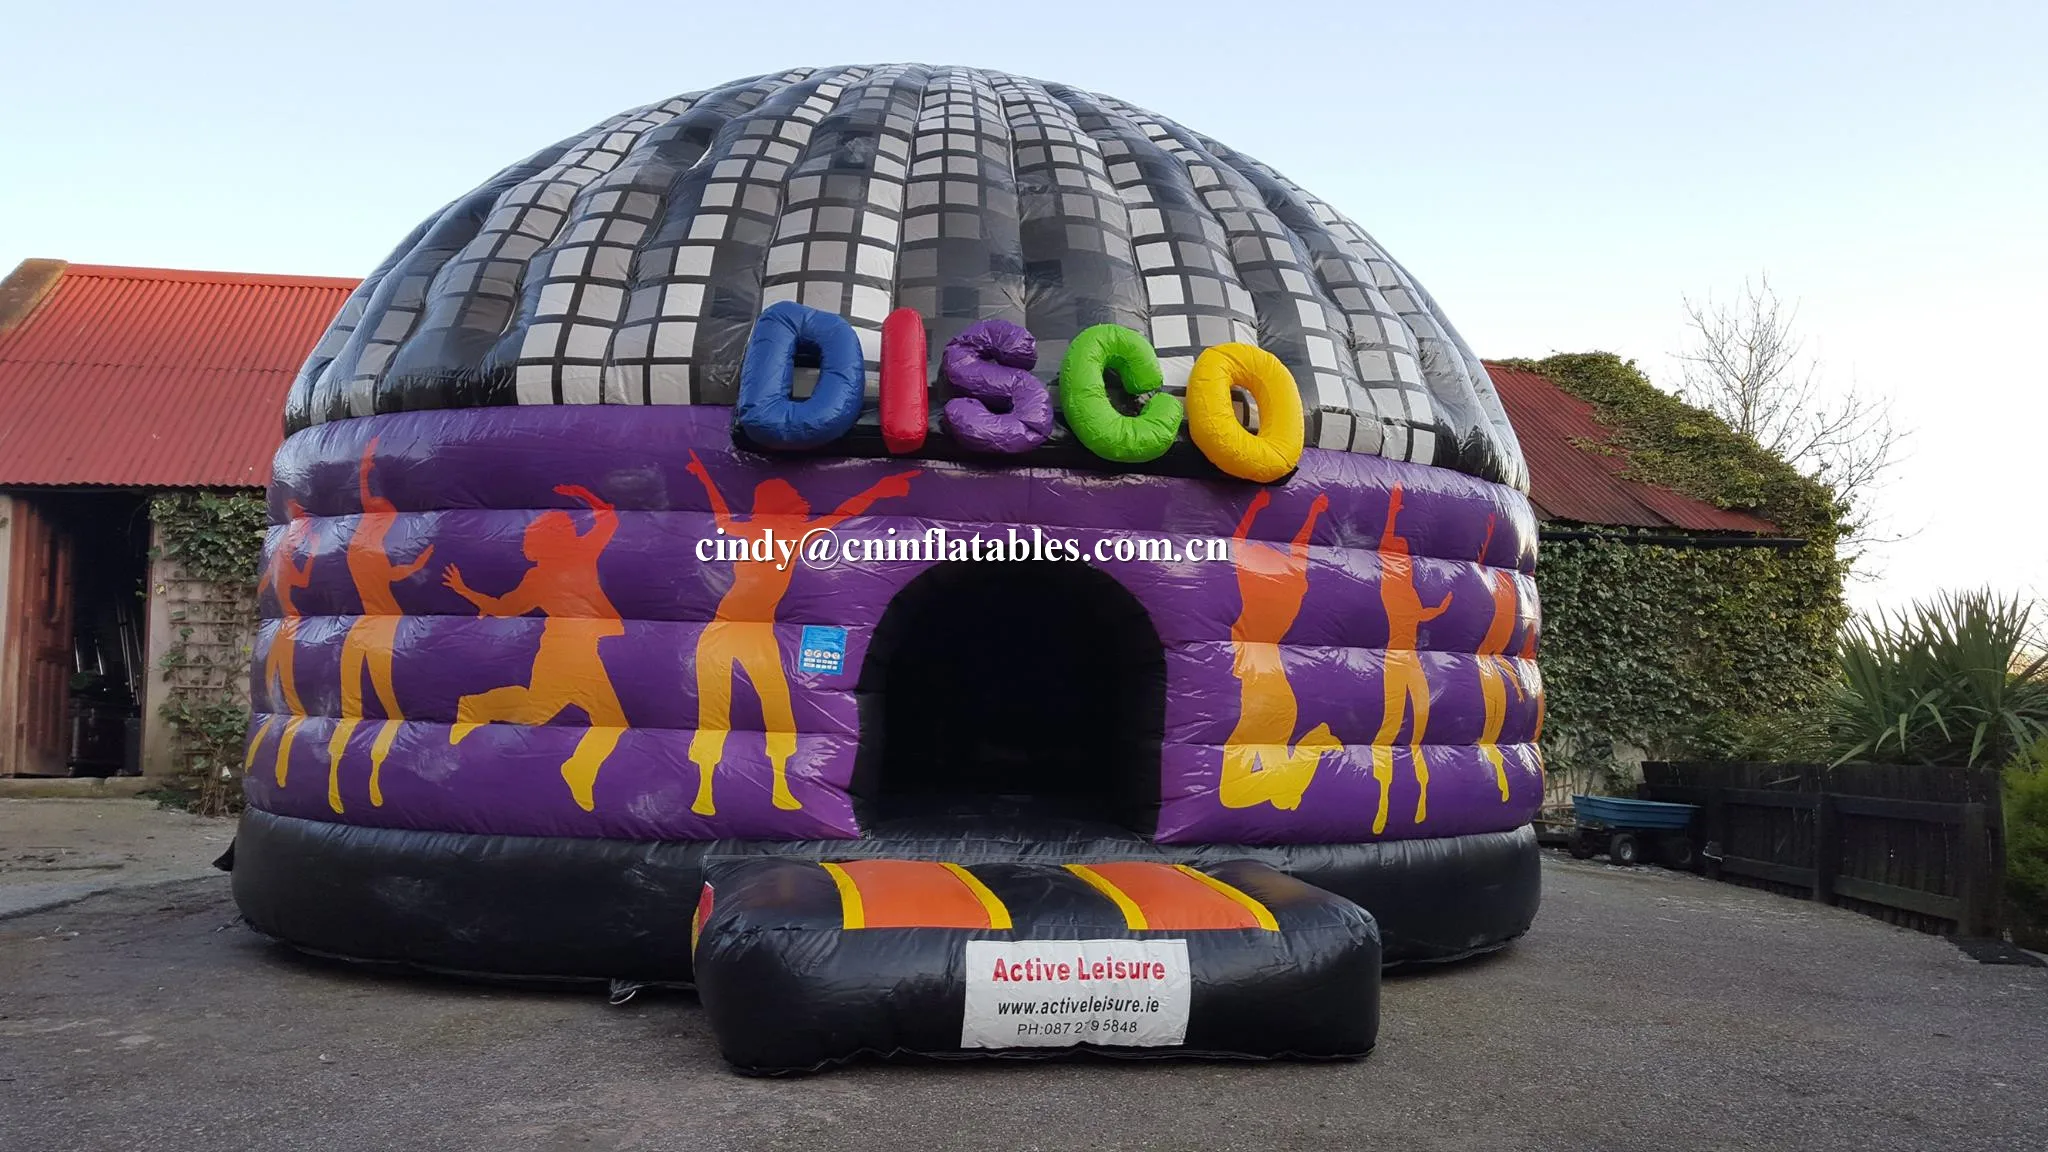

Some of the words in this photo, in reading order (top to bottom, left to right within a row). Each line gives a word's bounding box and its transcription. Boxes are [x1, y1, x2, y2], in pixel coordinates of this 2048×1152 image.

[738, 300, 1305, 483] DISCO
[992, 957, 1071, 982] Active
[1077, 956, 1166, 981] Leisure
[997, 995, 1160, 1015] www.activeleisure.ie
[1074, 1019, 1100, 1034] 29
[1102, 1018, 1138, 1033] 5848
